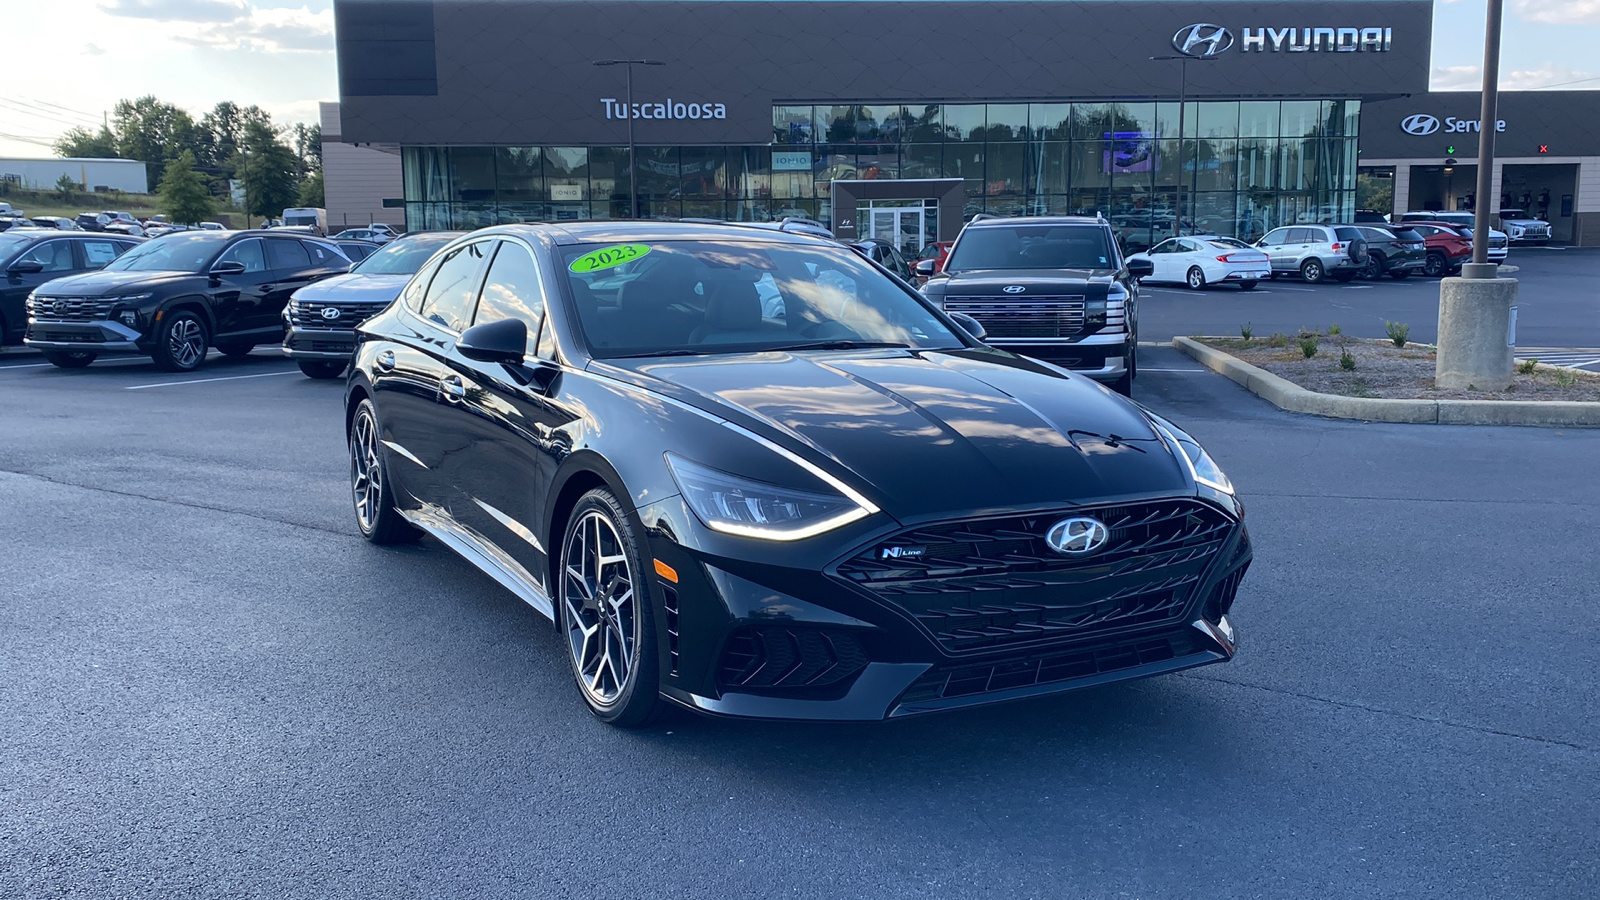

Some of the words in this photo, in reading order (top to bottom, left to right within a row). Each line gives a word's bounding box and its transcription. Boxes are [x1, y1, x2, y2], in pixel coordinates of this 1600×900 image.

[1242, 27, 1392, 52] HYUNDAI
[600, 98, 726, 119] Tuscaloosa
[1445, 117, 1506, 132] Serve
[585, 245, 637, 269] 2023
